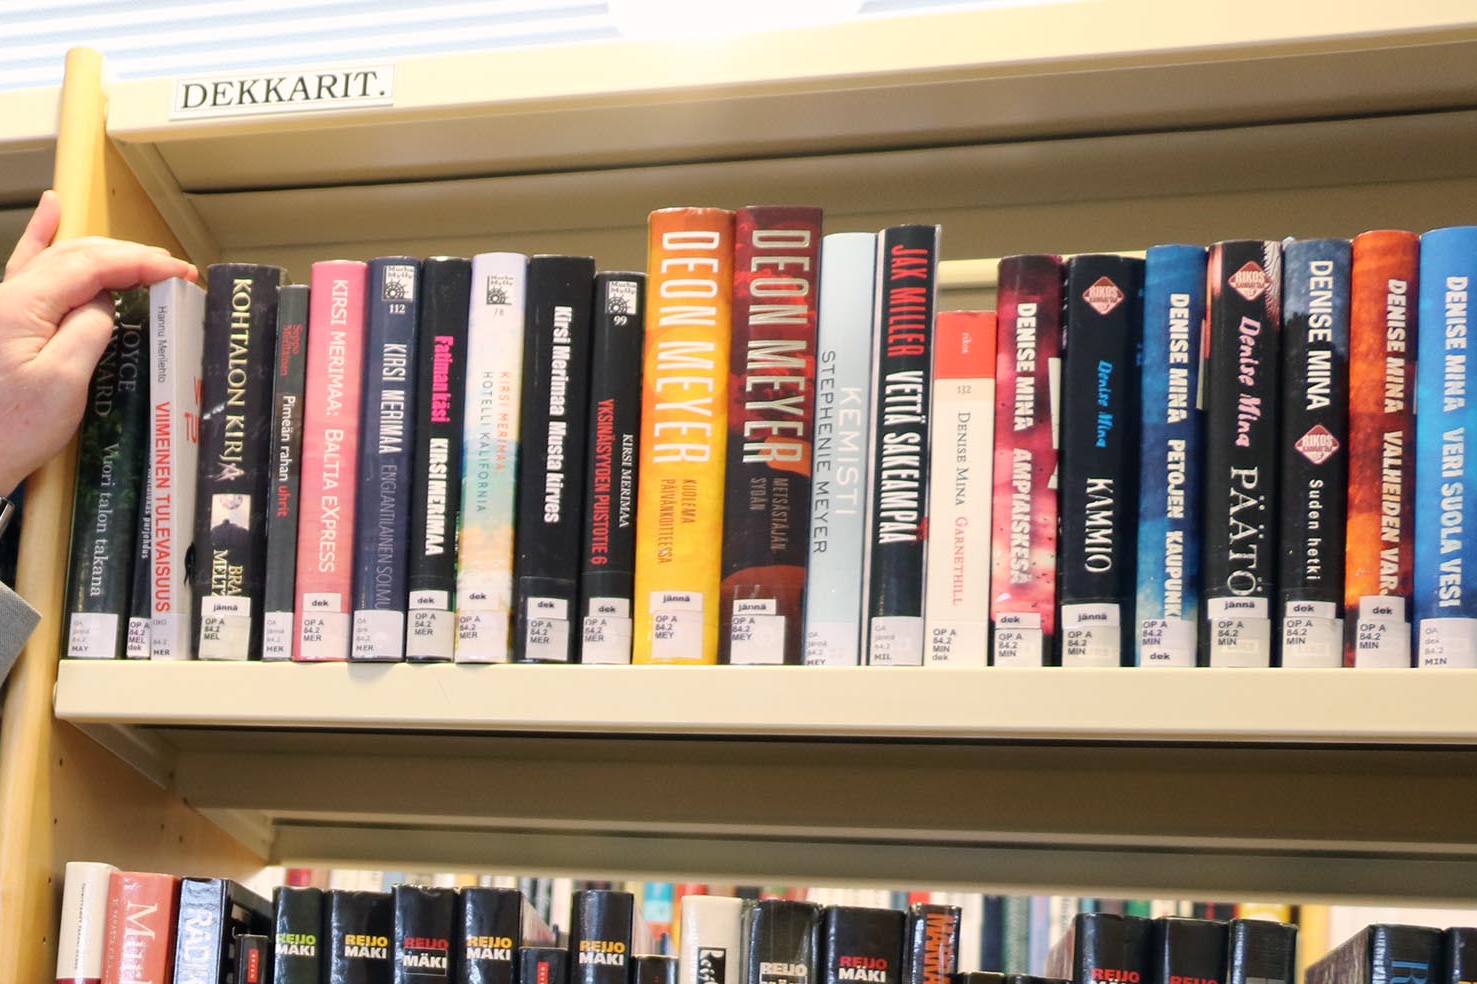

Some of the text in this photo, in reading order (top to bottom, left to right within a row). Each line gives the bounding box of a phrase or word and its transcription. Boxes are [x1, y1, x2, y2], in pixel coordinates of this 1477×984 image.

[180, 70, 386, 109] DEKKARIT.
[227, 279, 252, 406] KOHTALON
[389, 304, 406, 314] 112
[652, 231, 720, 463] DEON MEYER
[742, 230, 811, 463] DEON MEYER
[1306, 261, 1333, 411] DENISE MINA
[318, 279, 348, 573] KIRSI MERIMAA: BALTIA EXPRESS
[379, 344, 407, 454] KIRSI MERIMAA
[544, 306, 572, 523] Kirsi Merimaa Musta kirves
[879, 244, 928, 544] JAX MILLER VETTÄ SAKEAMPAA
[1010, 303, 1037, 584] DENISE MINA AMPIAISKESÄ
[1166, 293, 1190, 519] DENISE MINA PETOJEN
[1235, 315, 1261, 447] Denise Mina
[1380, 279, 1406, 542] DENISE MINA VALHEIDEN
[1438, 276, 1468, 607] DENISE MINA VERI SUOLA VESI
[155, 401, 171, 613] VIIMEINEN TULEVAISUUS
[425, 438, 448, 555] KIRSI MERIMAA
[812, 351, 837, 553] STEPHENIE MEYER
[834, 387, 862, 515] KEMISTI
[591, 494, 610, 555] PUISTOTIE
[1085, 477, 1114, 573] KAMMIO
[1306, 479, 1323, 581] Suden hetki
[1078, 613, 1107, 622] jännä
[466, 936, 513, 949] REIJO
[466, 947, 512, 961] MÄKI
[838, 966, 887, 983] MÄKI
[839, 956, 888, 970] REIJO
